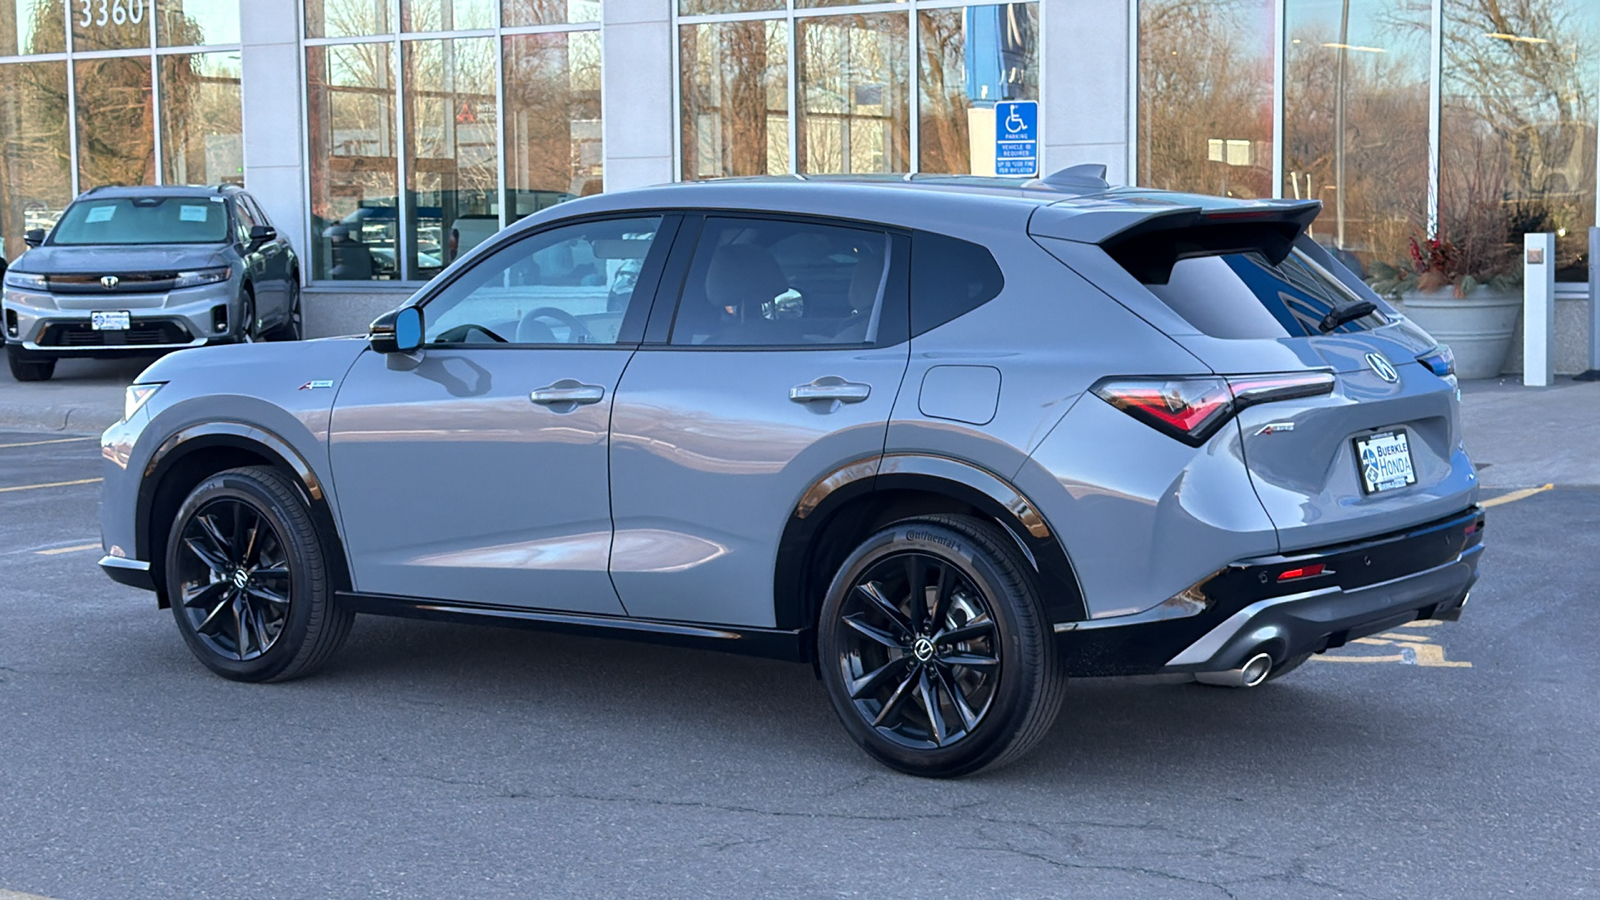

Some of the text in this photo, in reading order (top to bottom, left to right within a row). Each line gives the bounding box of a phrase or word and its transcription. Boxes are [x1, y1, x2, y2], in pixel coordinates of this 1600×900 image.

[80, 0, 143, 27] 3360
[1376, 442, 1407, 457] BUERKLE
[1379, 457, 1411, 477] HONDA
[906, 530, 956, 549] Continental
